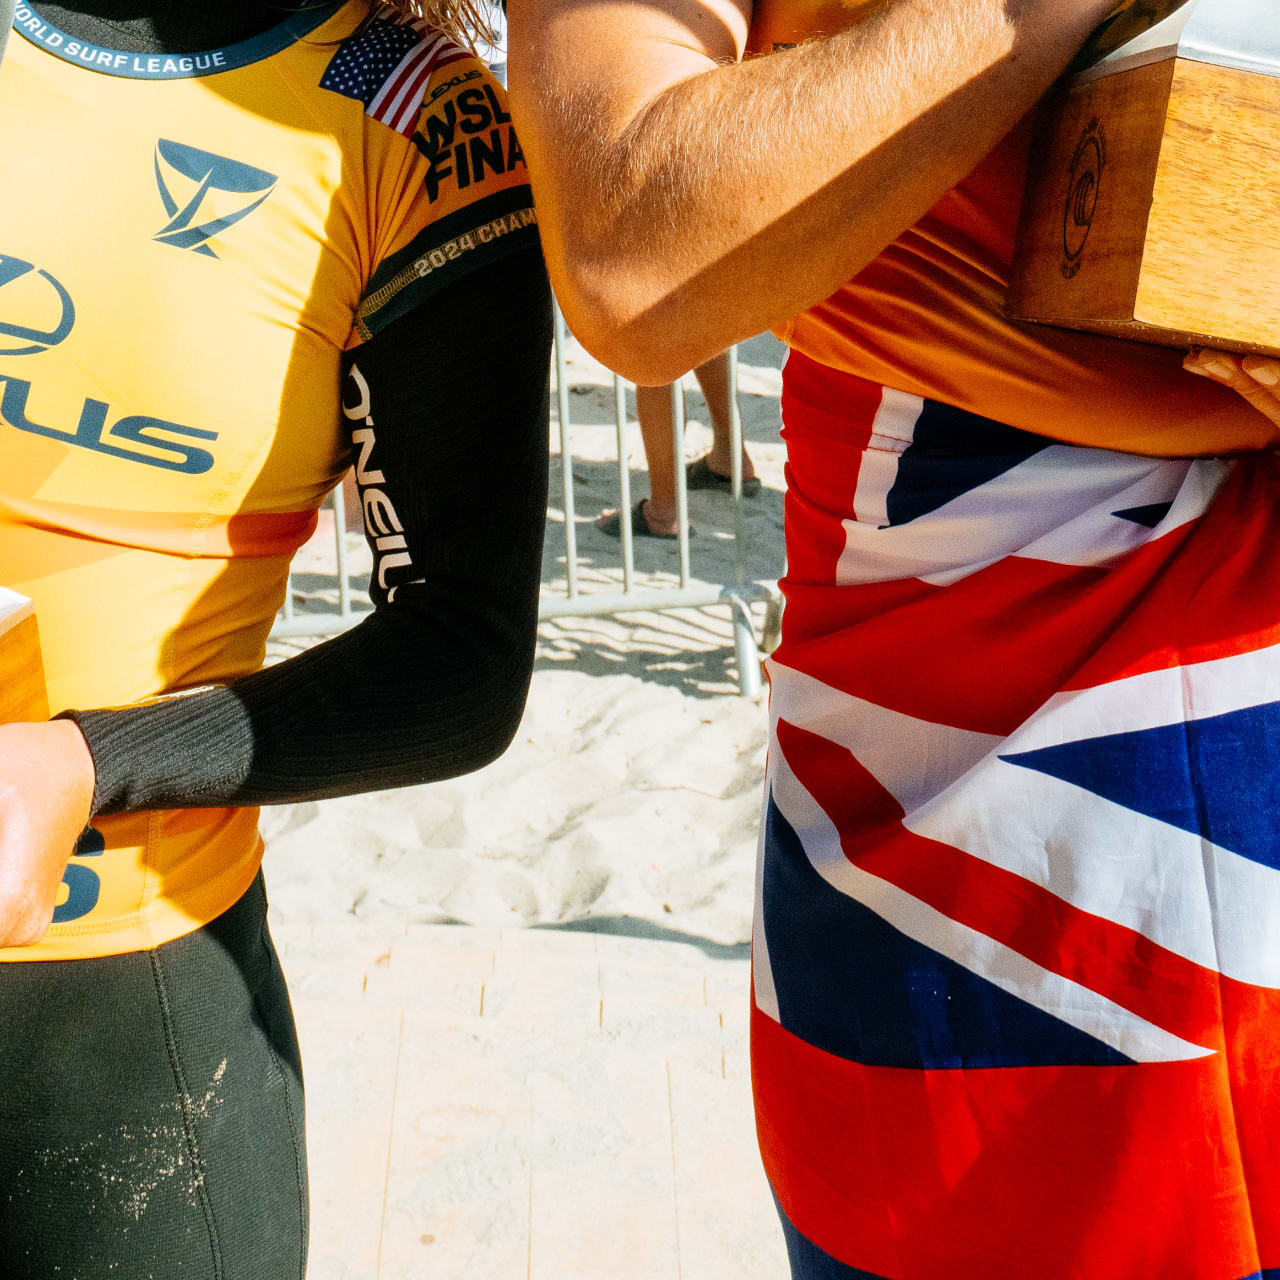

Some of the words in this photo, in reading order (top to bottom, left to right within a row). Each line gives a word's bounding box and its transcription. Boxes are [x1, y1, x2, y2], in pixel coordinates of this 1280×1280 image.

[64, 42, 128, 68] SURF
[133, 51, 227, 73] LEAGUE
[410, 83, 513, 161] WSL
[414, 234, 475, 278] 2024
